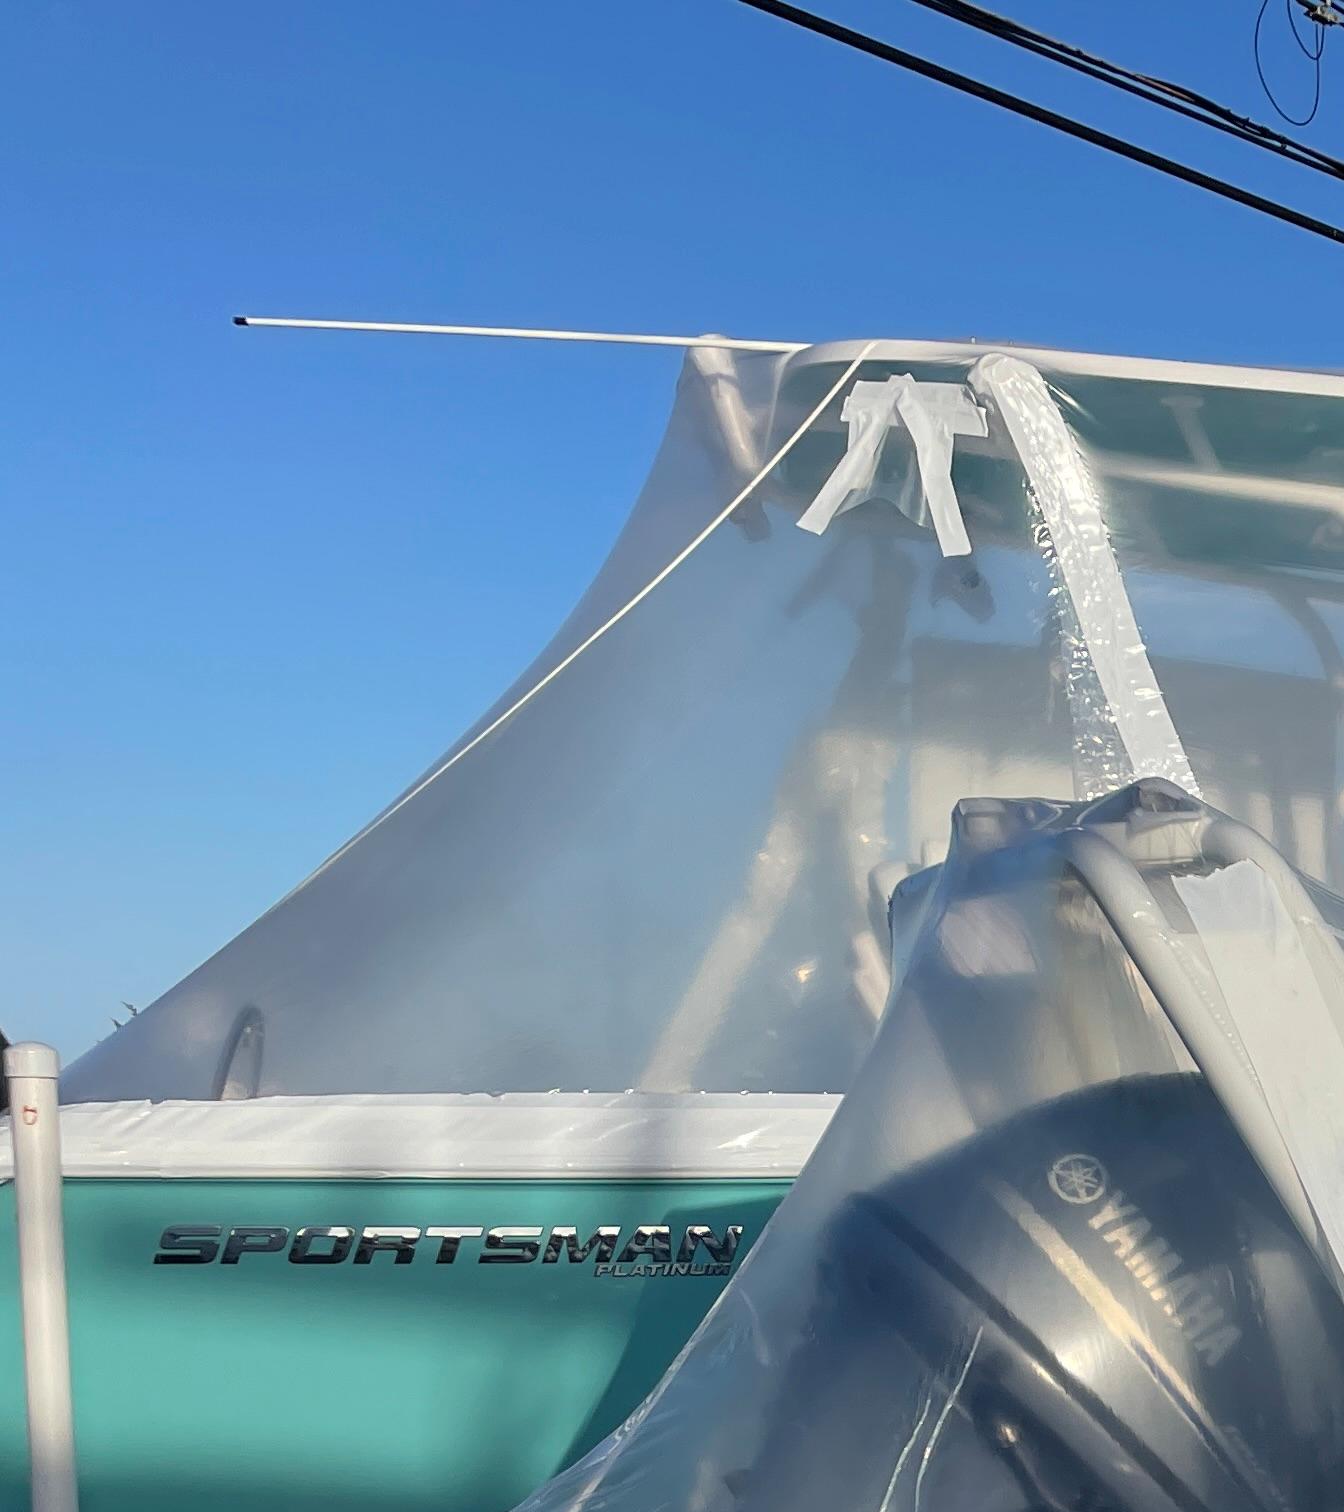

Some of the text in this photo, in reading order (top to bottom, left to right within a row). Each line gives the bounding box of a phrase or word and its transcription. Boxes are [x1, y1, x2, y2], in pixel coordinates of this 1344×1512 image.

[153, 1225, 743, 1264] SPORTSMAN
[594, 1262, 731, 1277] PLATINUM
[1088, 1190, 1242, 1366] YAMAHA
